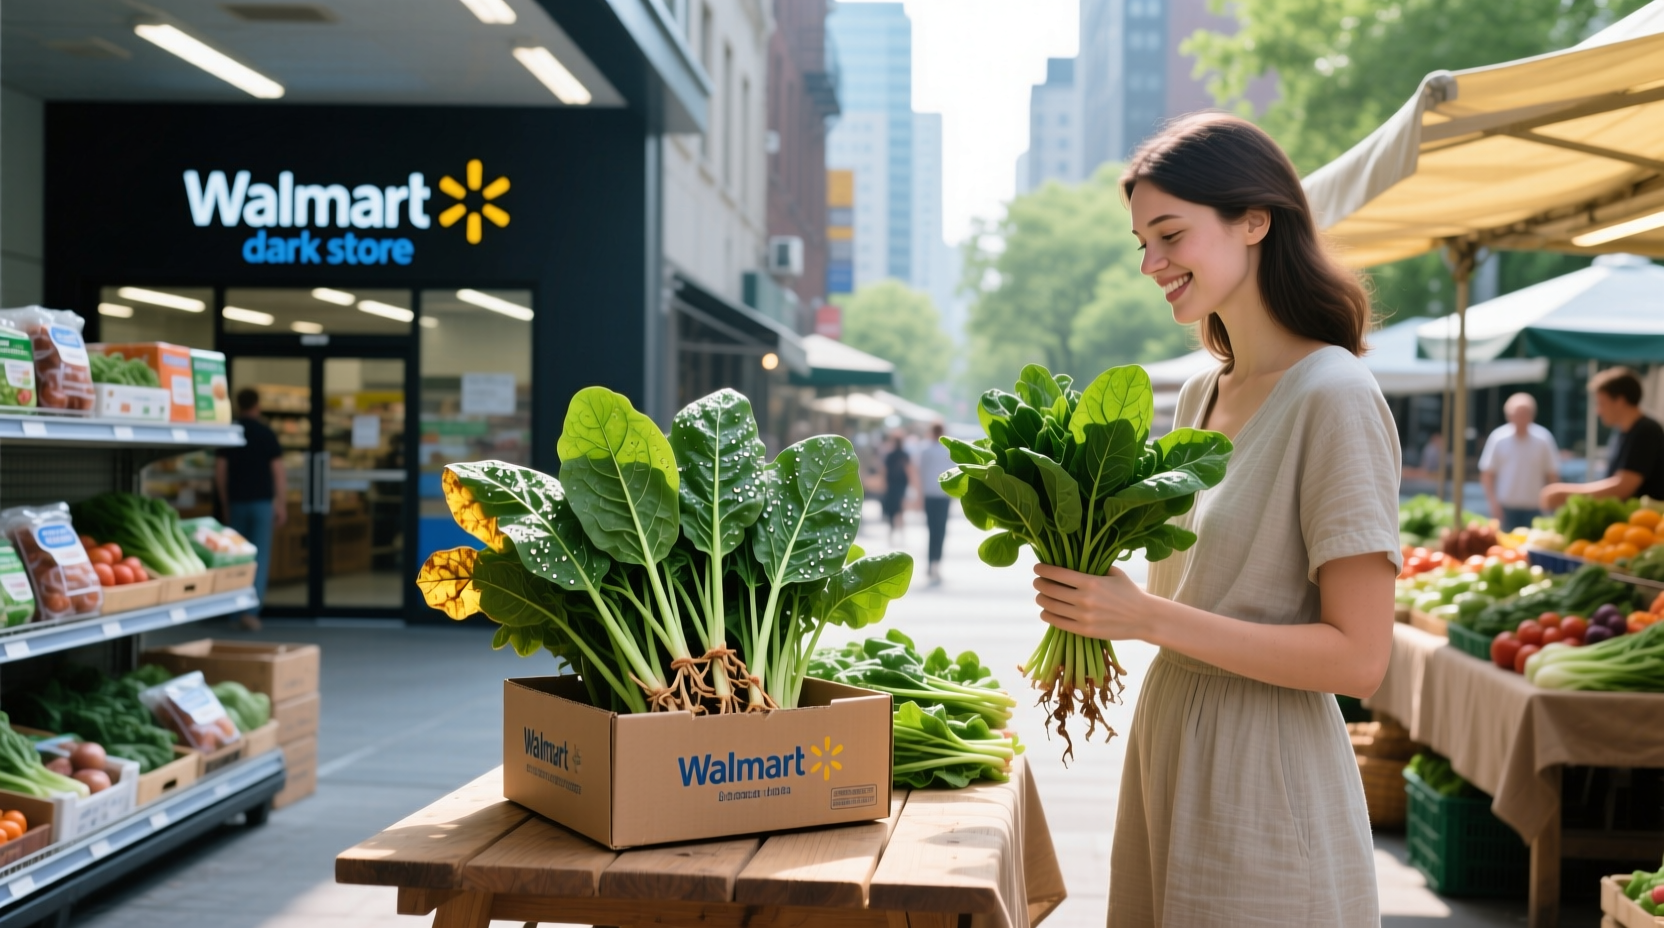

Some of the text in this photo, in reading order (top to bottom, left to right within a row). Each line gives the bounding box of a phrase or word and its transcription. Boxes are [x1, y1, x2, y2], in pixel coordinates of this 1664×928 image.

[183, 169, 431, 229] Walmart
[242, 229, 414, 265] dark store
[524, 726, 569, 772] Walmart
[678, 745, 805, 787] Walmart
